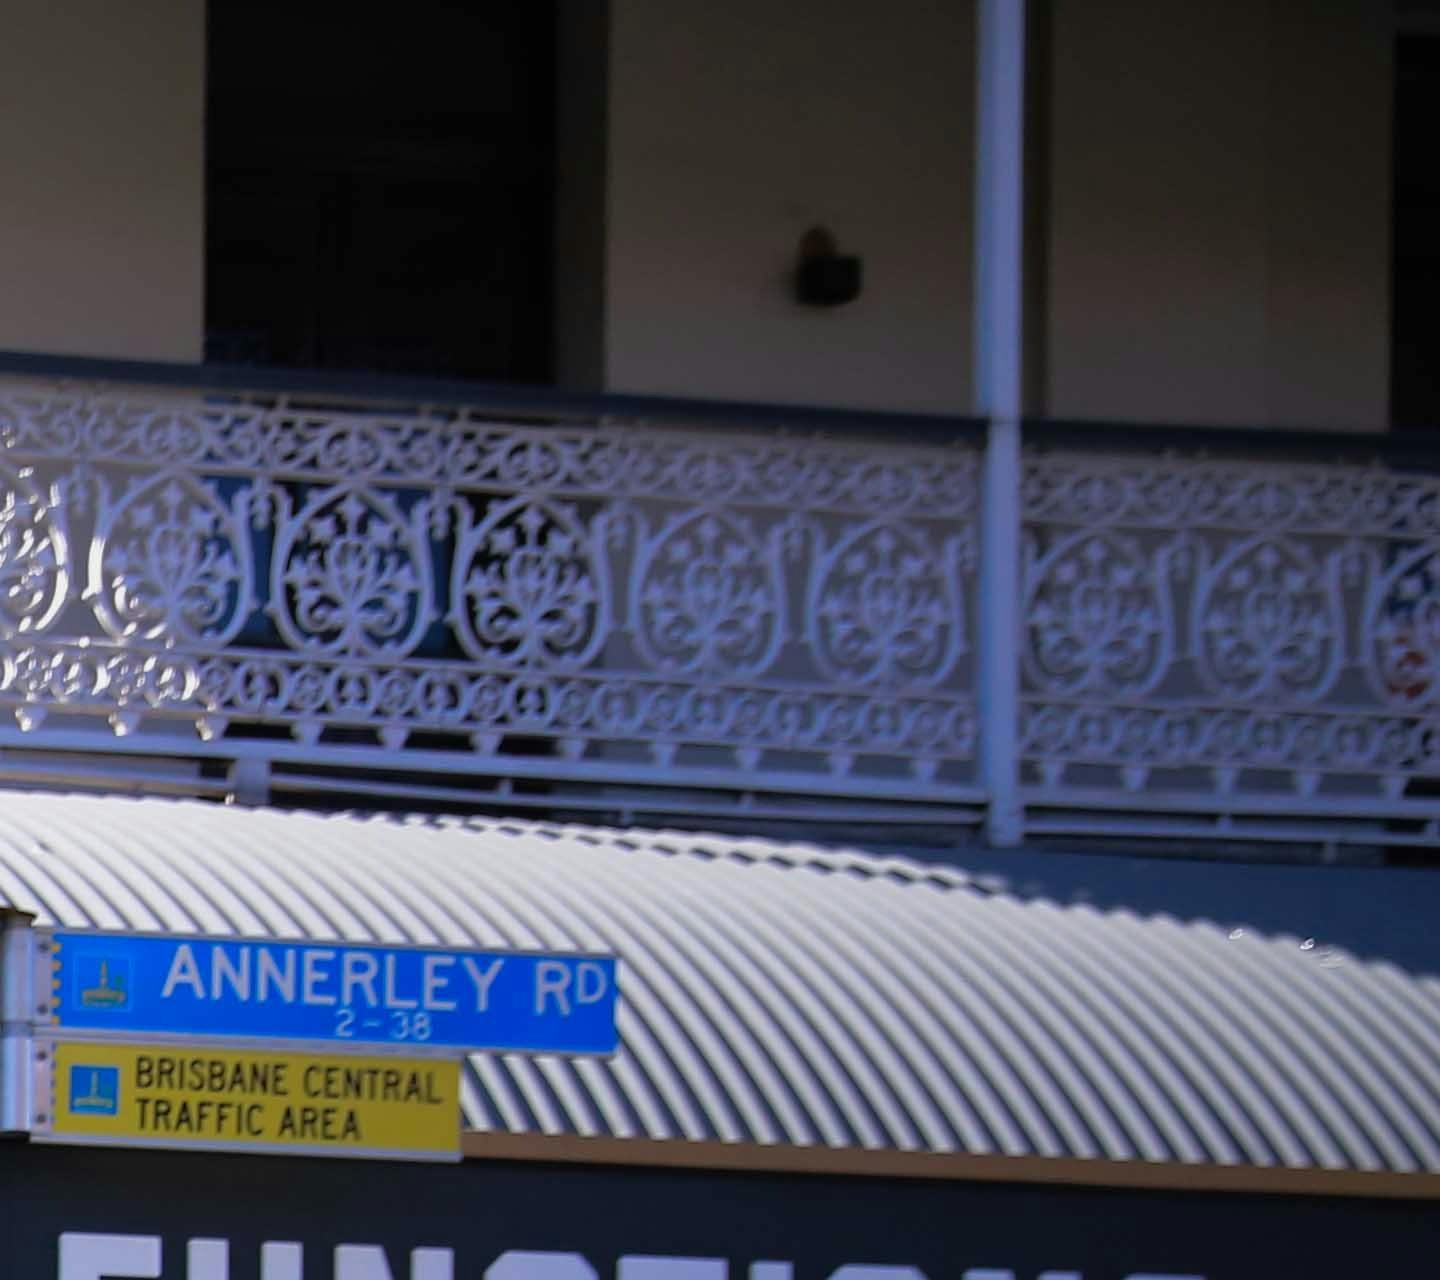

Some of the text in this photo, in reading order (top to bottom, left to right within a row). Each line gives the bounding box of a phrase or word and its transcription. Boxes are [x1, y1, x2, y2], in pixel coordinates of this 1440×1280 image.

[160, 943, 607, 1016] ANNERLEY RD
[136, 1056, 444, 1106] BRISBANE CENTRAL
[136, 1099, 361, 1141] TRAFFIC AREA
